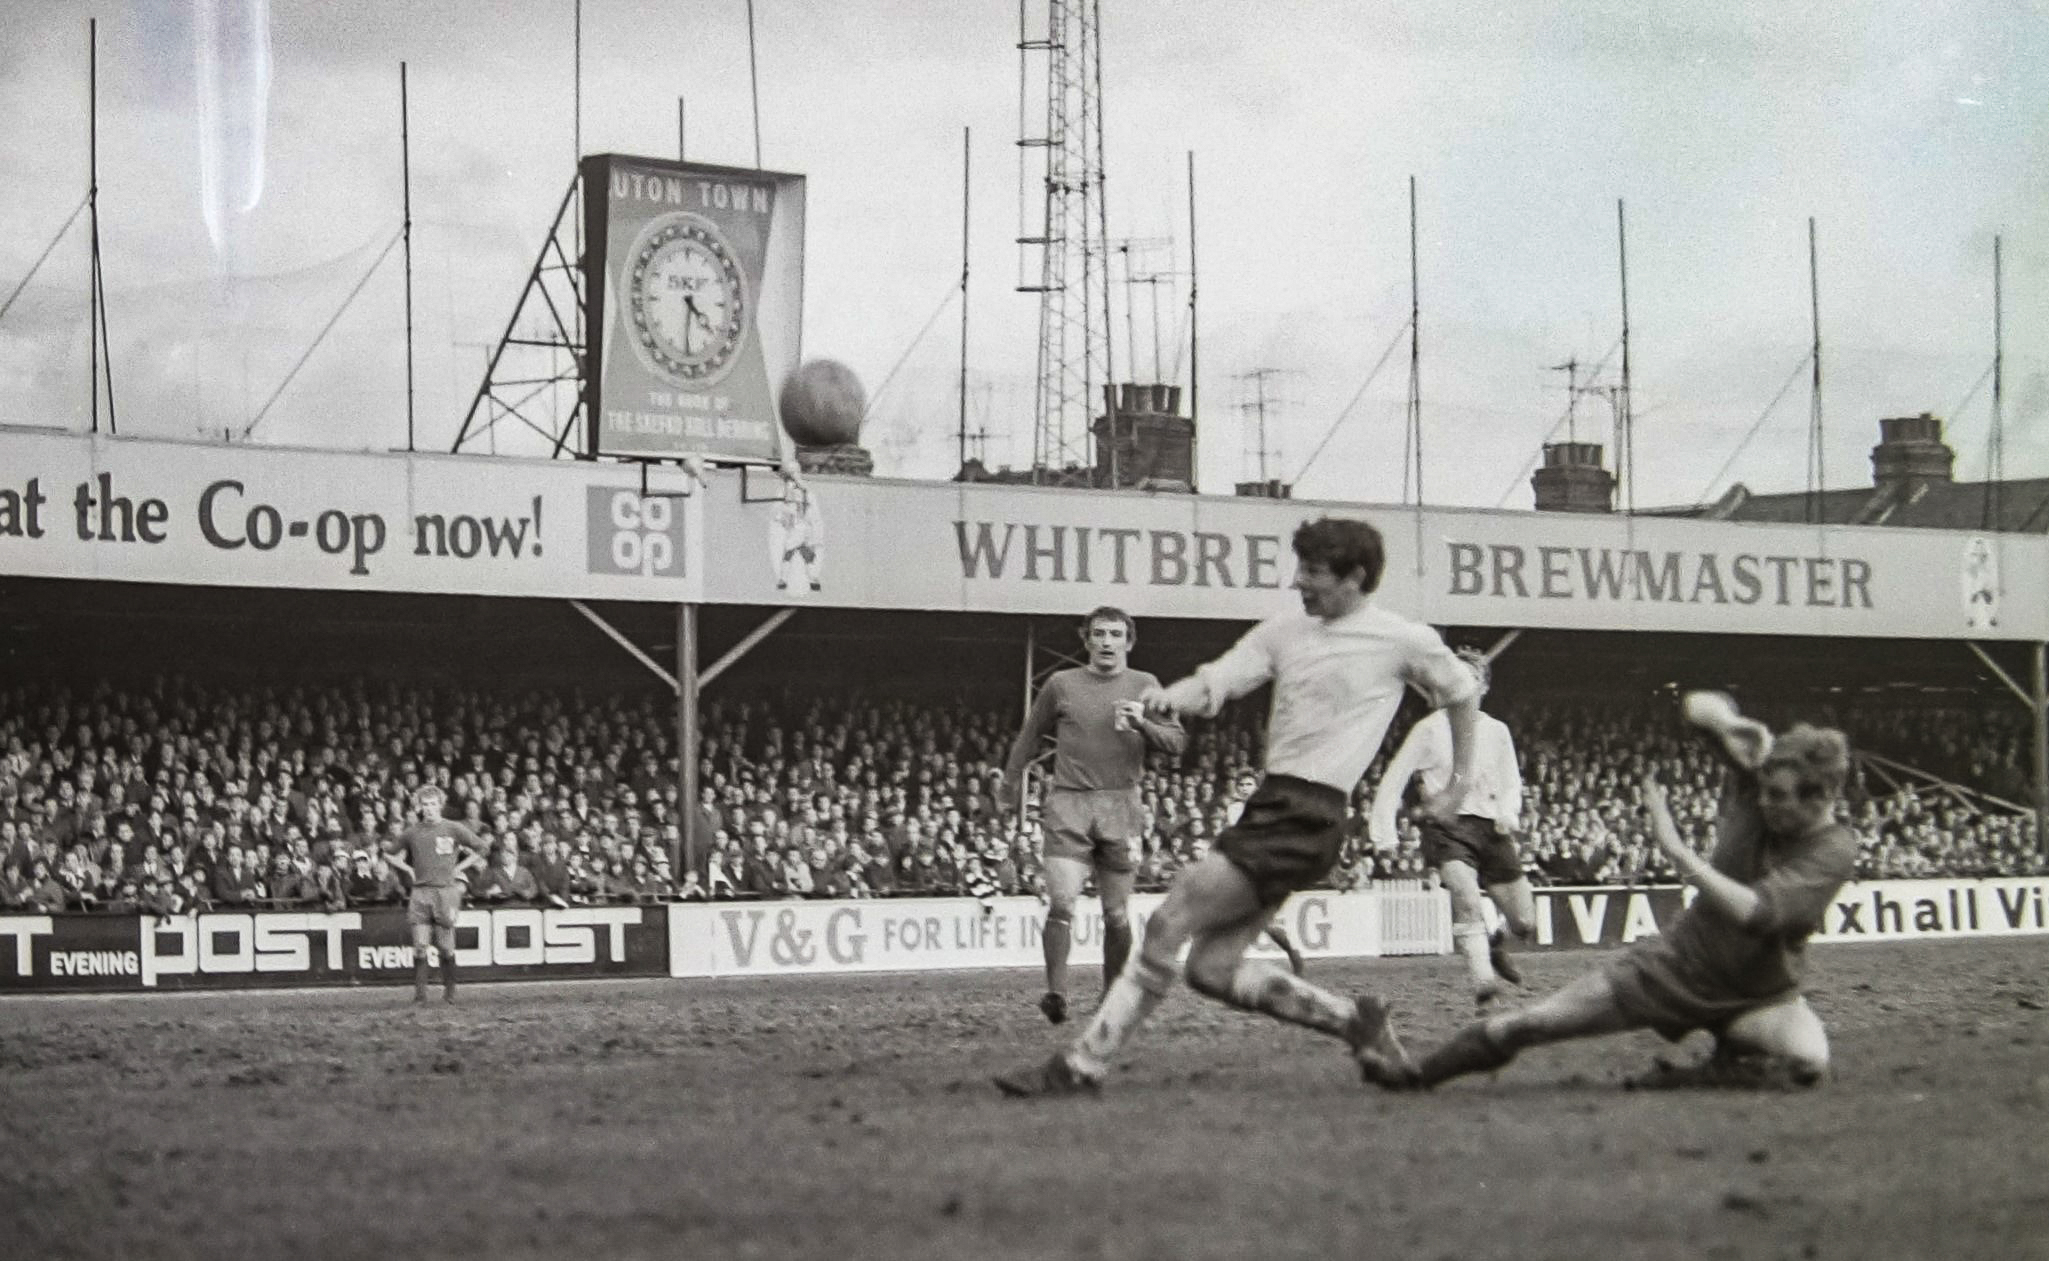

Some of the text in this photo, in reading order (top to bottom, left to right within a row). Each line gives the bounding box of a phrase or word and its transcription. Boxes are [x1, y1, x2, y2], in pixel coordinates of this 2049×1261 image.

[612, 171, 769, 214] UTON TOWN
[0, 471, 543, 575] at the Co-op now!
[952, 520, 1874, 608] WHITBRE BREWMASTER
[720, 906, 869, 968] V&G
[883, 916, 943, 952] FOR
[954, 914, 1008, 950] LIFE
[1818, 886, 2049, 935] xhall Vi
[50, 950, 139, 976] EVENING
[358, 945, 440, 970] EVENIG
